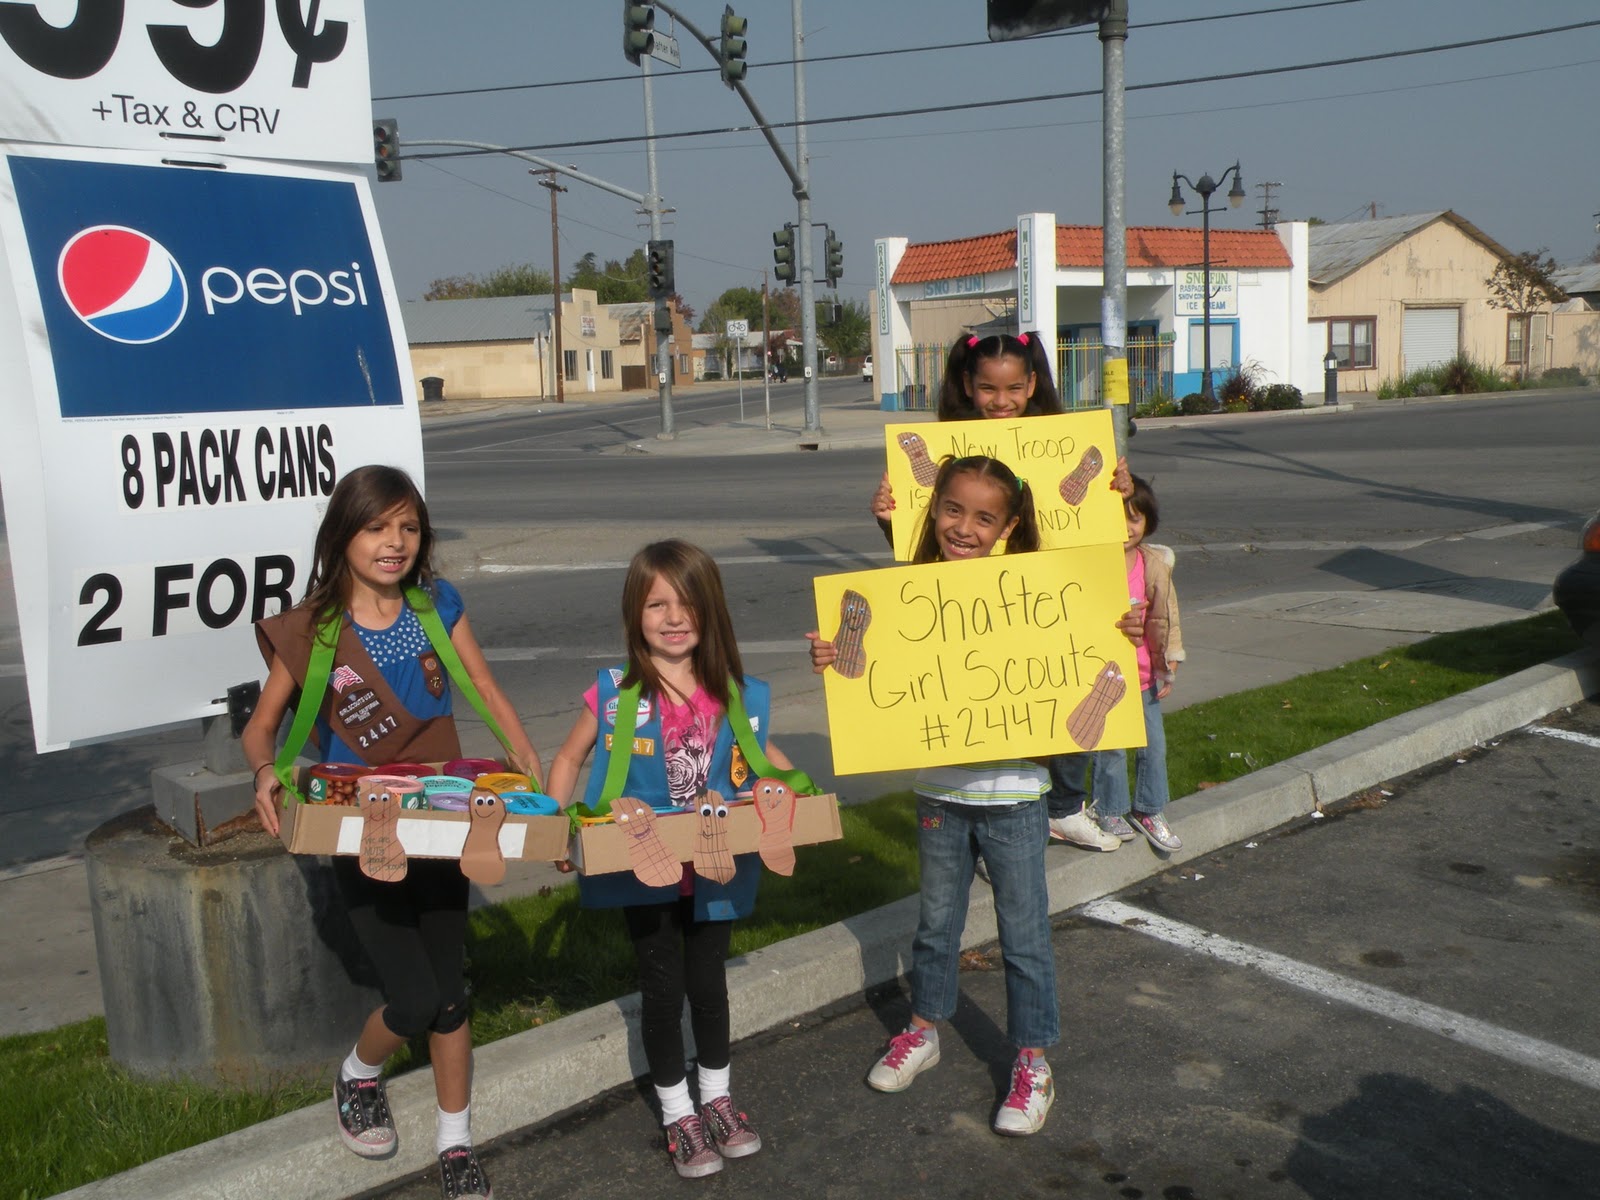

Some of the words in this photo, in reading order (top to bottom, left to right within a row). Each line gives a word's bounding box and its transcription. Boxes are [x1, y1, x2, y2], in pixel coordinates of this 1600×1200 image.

[92, 94, 171, 127] +Tax
[182, 101, 205, 129] &
[214, 103, 281, 134] CRV
[201, 262, 368, 315] pepsi
[878, 246, 887, 330] RASPADOS
[926, 280, 950, 297] SNO
[956, 276, 982, 293] FUN
[1180, 284, 1205, 292] RASPADO
[1209, 272, 1228, 284] FUN
[1186, 302, 1198, 310] ICE
[951, 434, 998, 459] New
[1007, 426, 1075, 462] Troop
[121, 434, 145, 510] 8
[152, 428, 248, 508] PACK
[254, 423, 336, 502] CANS
[77, 572, 123, 647] 2
[152, 554, 296, 637] FOR
[898, 570, 1082, 642] Shafter
[868, 654, 948, 709] Girl
[964, 633, 1107, 701] Scouts
[359, 715, 397, 748] 2447
[608, 737, 652, 753] 247
[920, 699, 1057, 751] #2447
